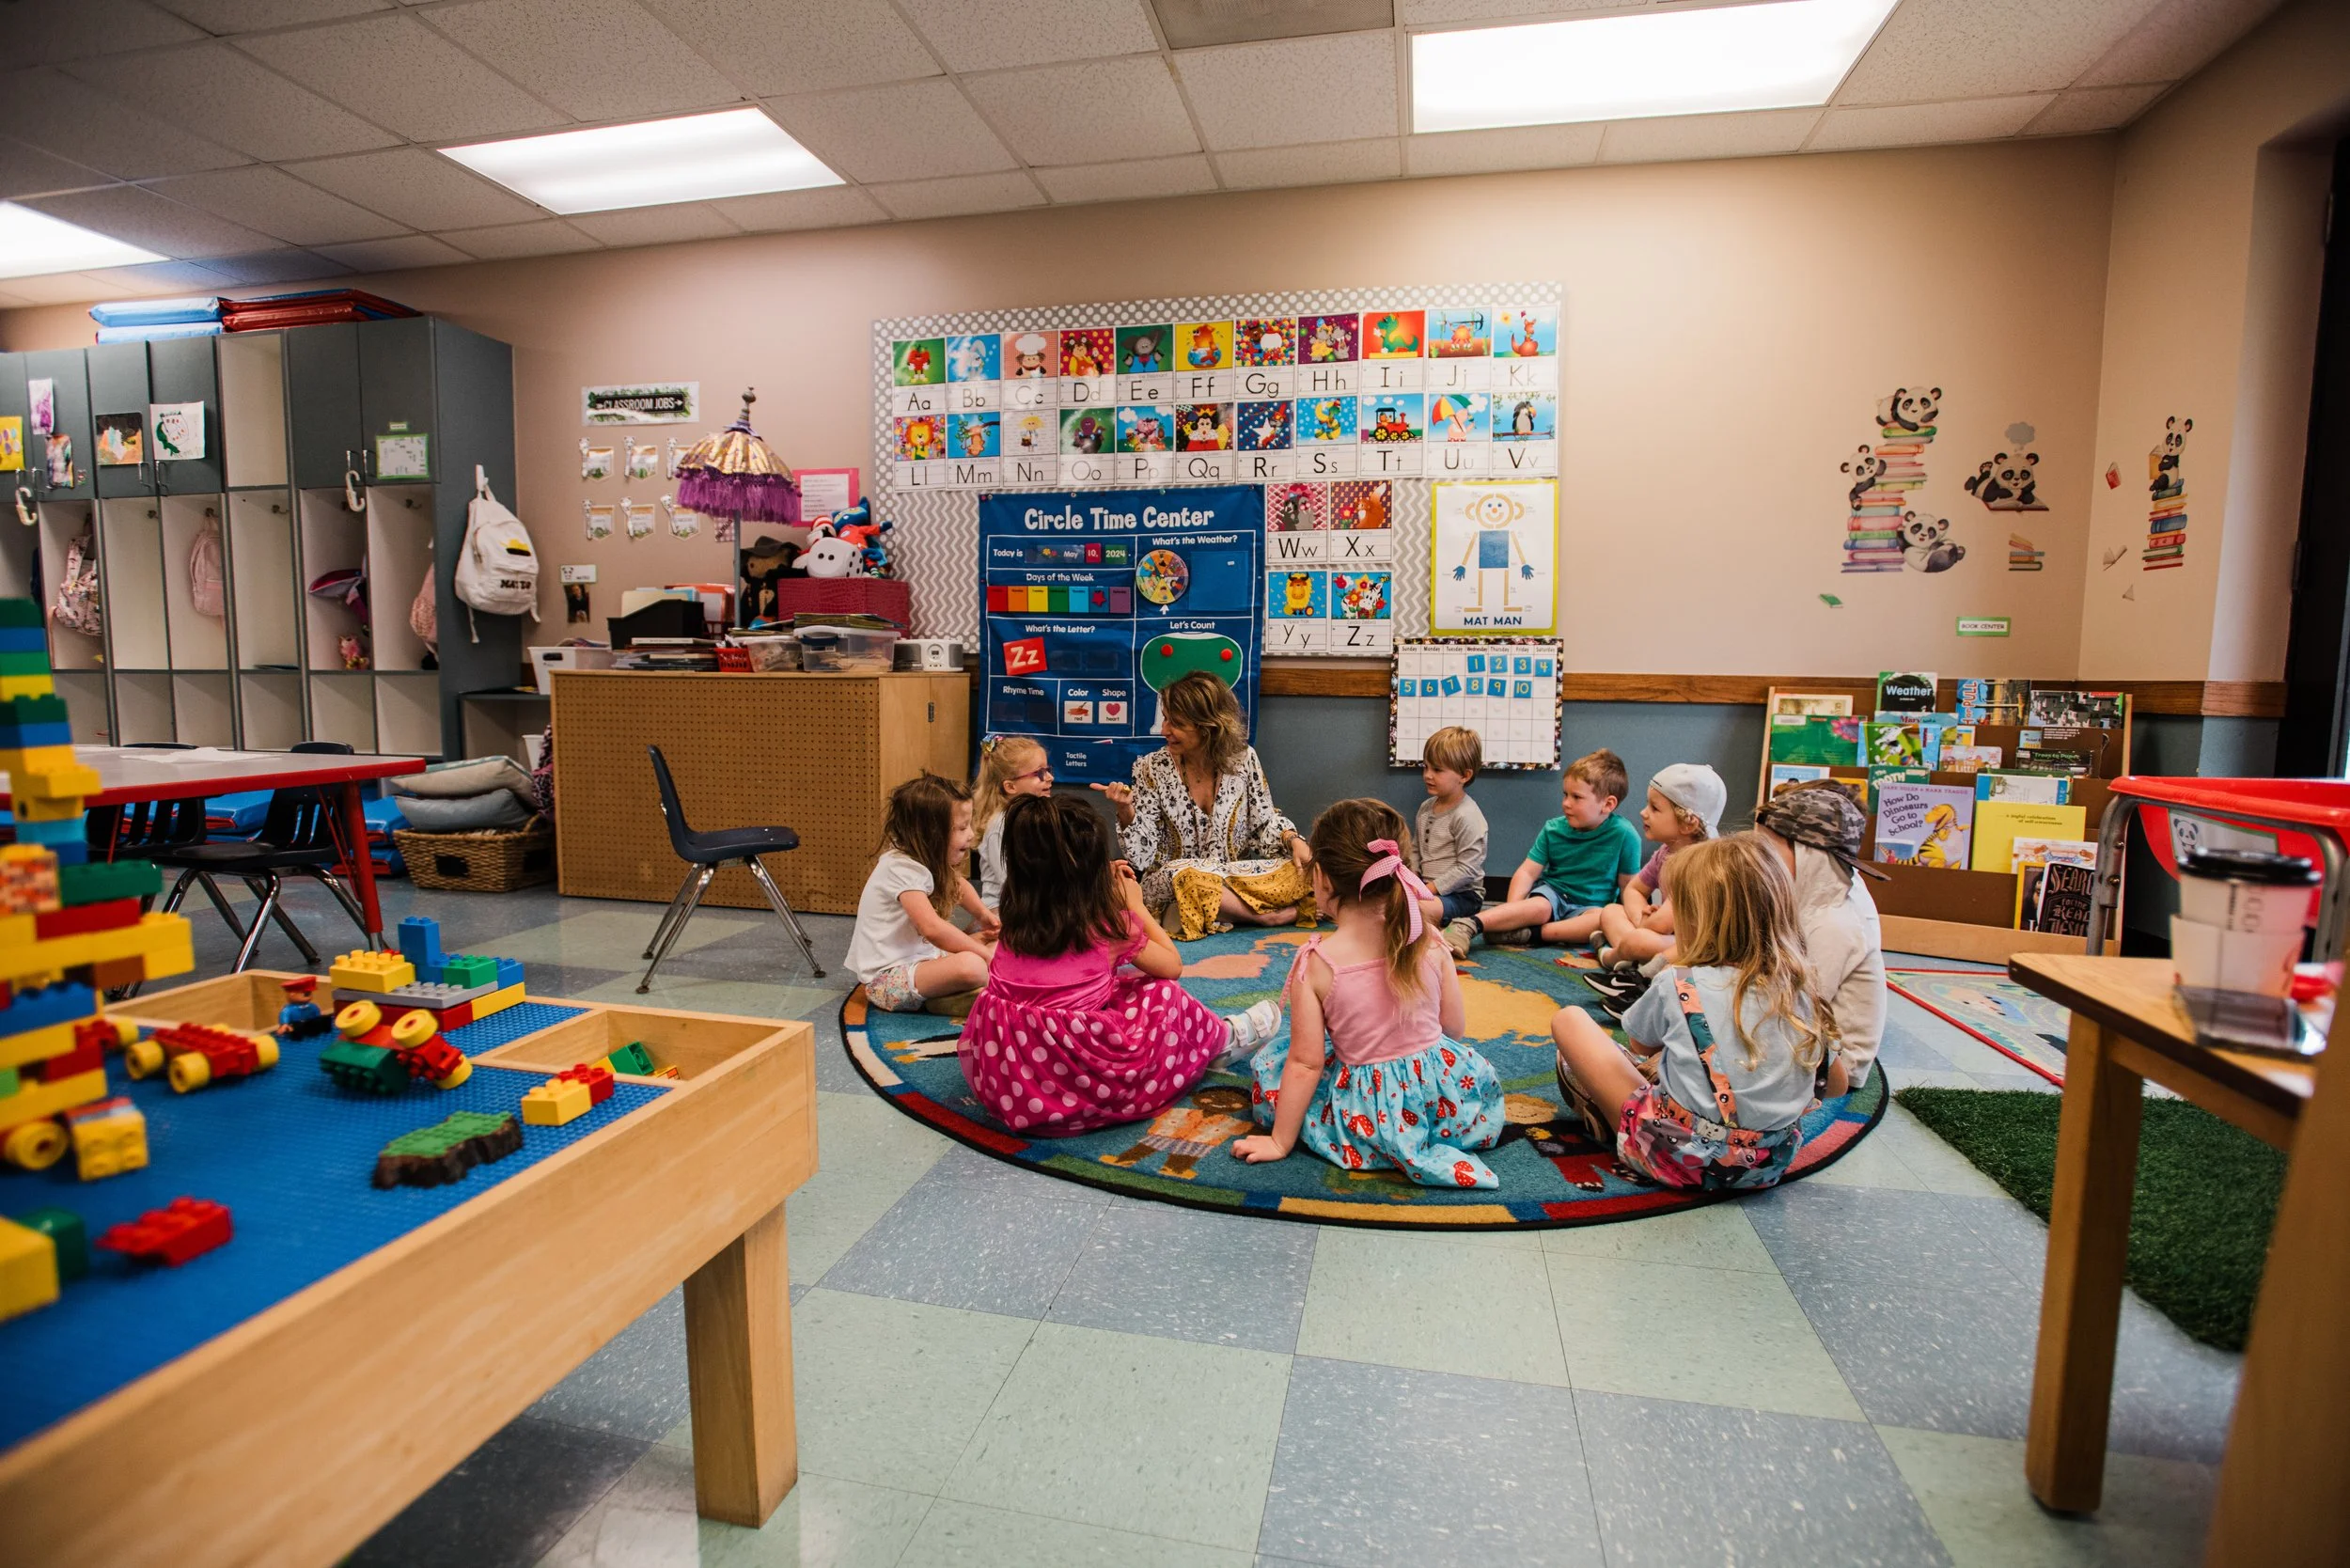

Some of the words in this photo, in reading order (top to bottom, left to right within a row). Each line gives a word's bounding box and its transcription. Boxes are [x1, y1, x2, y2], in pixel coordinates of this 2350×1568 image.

[654, 397, 675, 409] JOBS
[1025, 504, 1084, 530] Circle
[1089, 507, 1137, 531] Time
[1143, 506, 1214, 528] Center
[1152, 537, 1181, 545] What's
[1182, 536, 1196, 544] the
[1197, 534, 1238, 544] Weather?
[993, 548, 1015, 557] Today
[1016, 548, 1024, 557] is
[1063, 550, 1079, 559] May
[1105, 549, 1126, 557] 2024
[1026, 573, 1045, 583] Days
[1071, 573, 1094, 582] Week
[1169, 620, 1189, 630] Let's
[1190, 620, 1215, 630] Count
[1464, 616, 1488, 626] MAT
[1494, 616, 1523, 625] MAN
[1025, 623, 1052, 634] What's
[1052, 624, 1066, 633] the
[1067, 624, 1096, 634] Letter?
[1010, 645, 1040, 668] Zz
[1496, 657, 1503, 670] 2
[1519, 658, 1528, 670] 3
[1539, 661, 1548, 673] 4
[1002, 685, 1027, 696] Rhyme
[1027, 688, 1044, 697] Time
[1068, 688, 1089, 697] Color
[1102, 688, 1127, 698] Shape
[1403, 681, 1412, 693] 5
[1426, 682, 1434, 693] 6
[1447, 679, 1454, 691] 7
[1471, 679, 1480, 691] 8
[1494, 682, 1502, 694] 9
[1516, 682, 1529, 695] 10
[1886, 685, 1933, 697] Weather
[1883, 795, 1904, 808] How
[1905, 792, 1919, 802] Do
[1883, 803, 1929, 819] Dinosaurs
[1891, 816, 1906, 824] Go
[1888, 820, 1924, 837] School?
